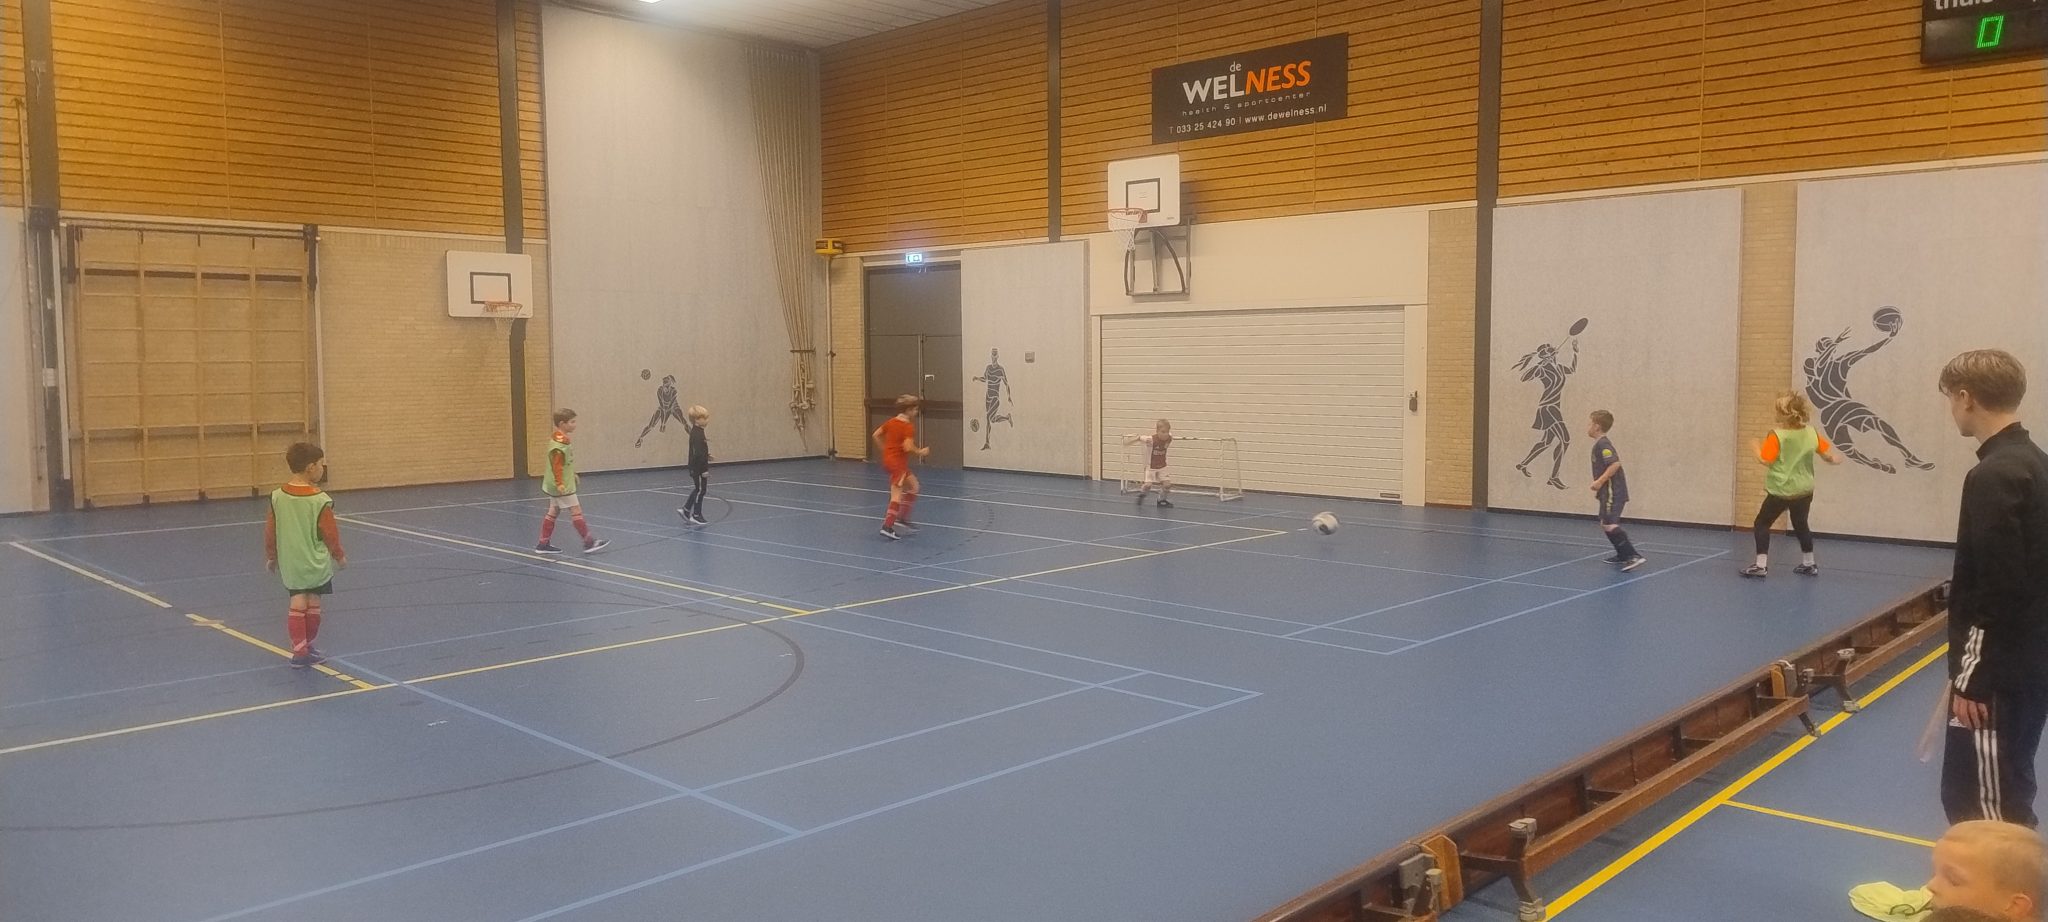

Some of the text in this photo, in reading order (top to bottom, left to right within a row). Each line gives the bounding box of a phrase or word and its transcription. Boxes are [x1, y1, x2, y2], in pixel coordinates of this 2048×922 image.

[1934, 0, 1994, 10] thu
[1977, 15, 2004, 48] 0
[1229, 61, 1242, 73] de
[1182, 60, 1312, 105] WELNESS
[1182, 106, 1217, 117] health
[1237, 92, 1311, 109] sportcenter
[1176, 124, 1192, 134] 033
[1194, 122, 1205, 131] 25
[1206, 120, 1223, 129] 424
[1225, 117, 1236, 127] 90
[1244, 104, 1327, 124] www.dewelness.nl
